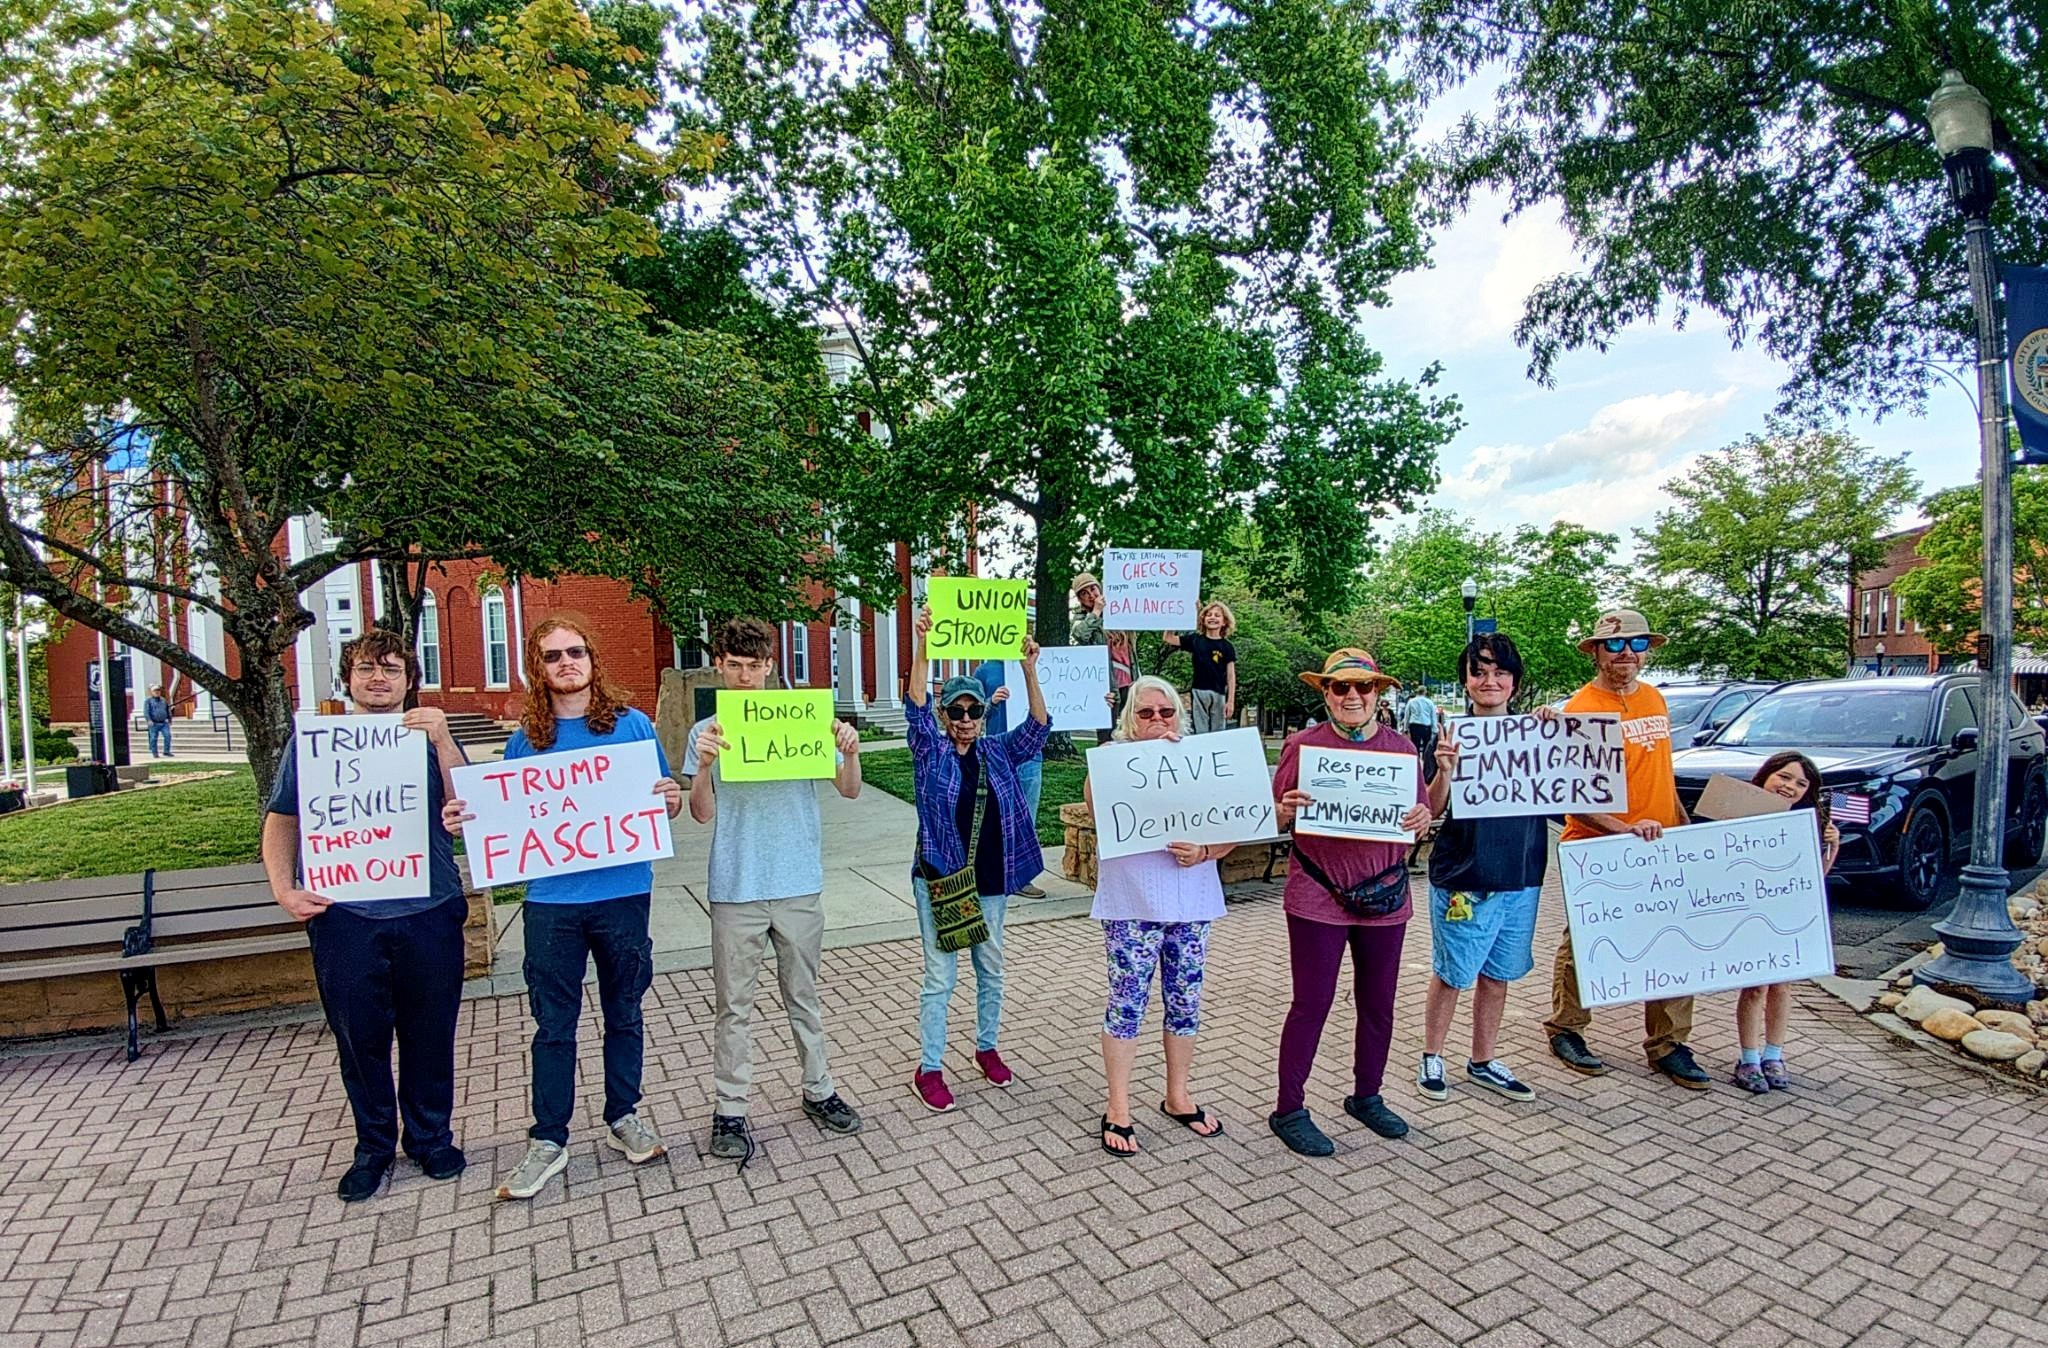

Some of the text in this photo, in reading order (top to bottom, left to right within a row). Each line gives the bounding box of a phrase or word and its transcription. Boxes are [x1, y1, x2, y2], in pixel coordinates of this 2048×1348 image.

[1122, 561, 1178, 581] CHECKS
[1140, 552, 1166, 560] EATING
[1173, 552, 1190, 560] THE
[957, 588, 1027, 610] UNION
[1136, 581, 1160, 590] EATING
[1110, 598, 1185, 615] BALANCES
[931, 617, 1020, 647] STRONG
[1051, 651, 1071, 664] has
[1037, 664, 1106, 685] O HOME
[744, 699, 816, 722] HONOR
[301, 725, 411, 757] TRUMP
[1458, 715, 1619, 750] SUPPORT
[335, 757, 361, 787] IS
[483, 755, 612, 801] TRUMP
[1126, 750, 1234, 789] SAVE
[1452, 743, 1625, 782] IMMIGRANT
[1463, 773, 1614, 806] WORKERS
[308, 783, 418, 831] SENILE
[529, 795, 579, 819] IS A
[1111, 801, 1272, 843] Democracy
[307, 825, 393, 854] THROW
[483, 808, 665, 880] FASCIST
[1569, 828, 1789, 879] You Can't be a Patriot
[308, 853, 425, 891] HIM OUT
[1650, 868, 1685, 893] And
[1574, 901, 1624, 926] Take
[1634, 896, 1680, 915] away
[1755, 877, 1813, 899] Benefits
[1590, 937, 1801, 1001] Not How it works!
